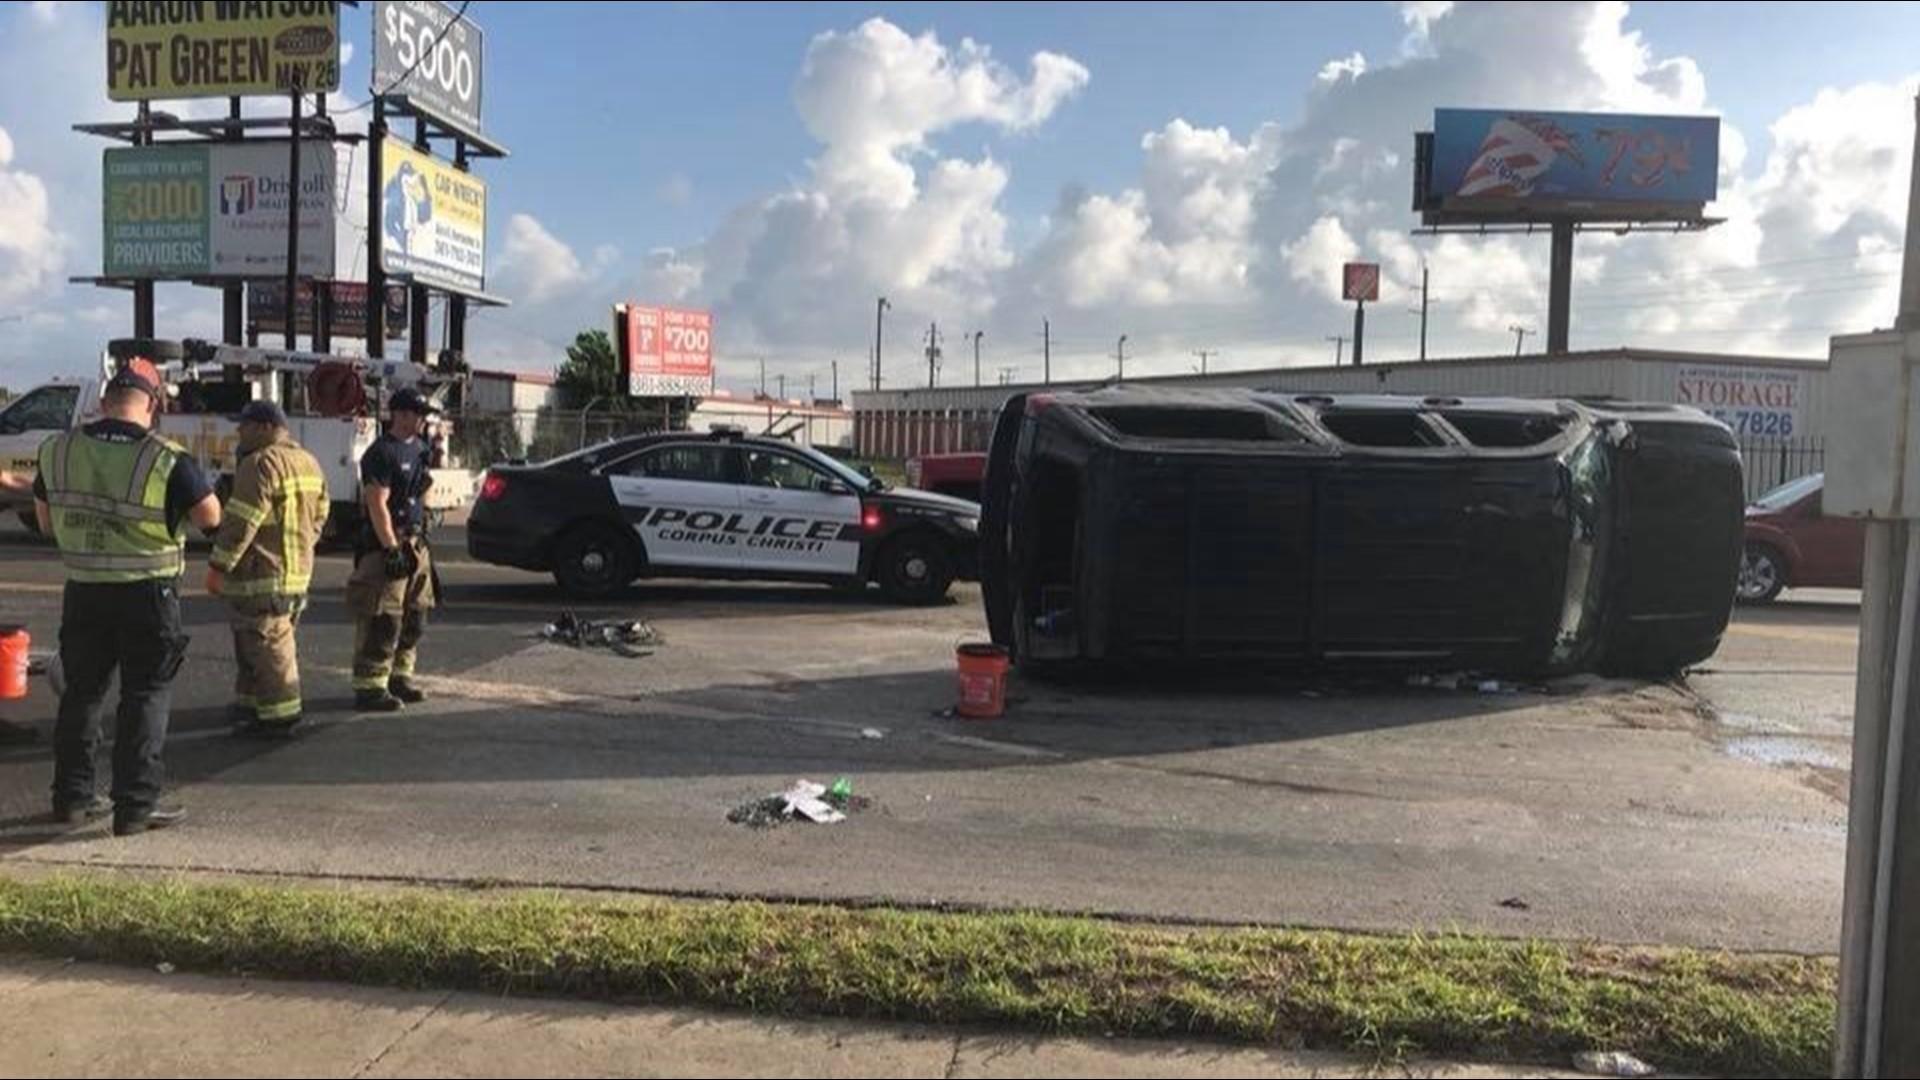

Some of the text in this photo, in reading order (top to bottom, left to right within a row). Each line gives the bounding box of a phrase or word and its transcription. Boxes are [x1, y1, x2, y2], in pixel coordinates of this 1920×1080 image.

[108, 38, 162, 89] PAT
[170, 34, 269, 87] GREEN
[385, 4, 472, 102] $5,000
[276, 59, 336, 90] MAY 25
[258, 173, 325, 195] Drisoll
[127, 180, 203, 221] 3000
[113, 241, 207, 265] PROVIDERS.
[663, 326, 710, 352] $700
[1678, 378, 1798, 409] STORAGE
[1705, 409, 1793, 436] 5-7826
[647, 507, 838, 541] POLICE
[658, 528, 824, 552] CORPUS CHRISTI
